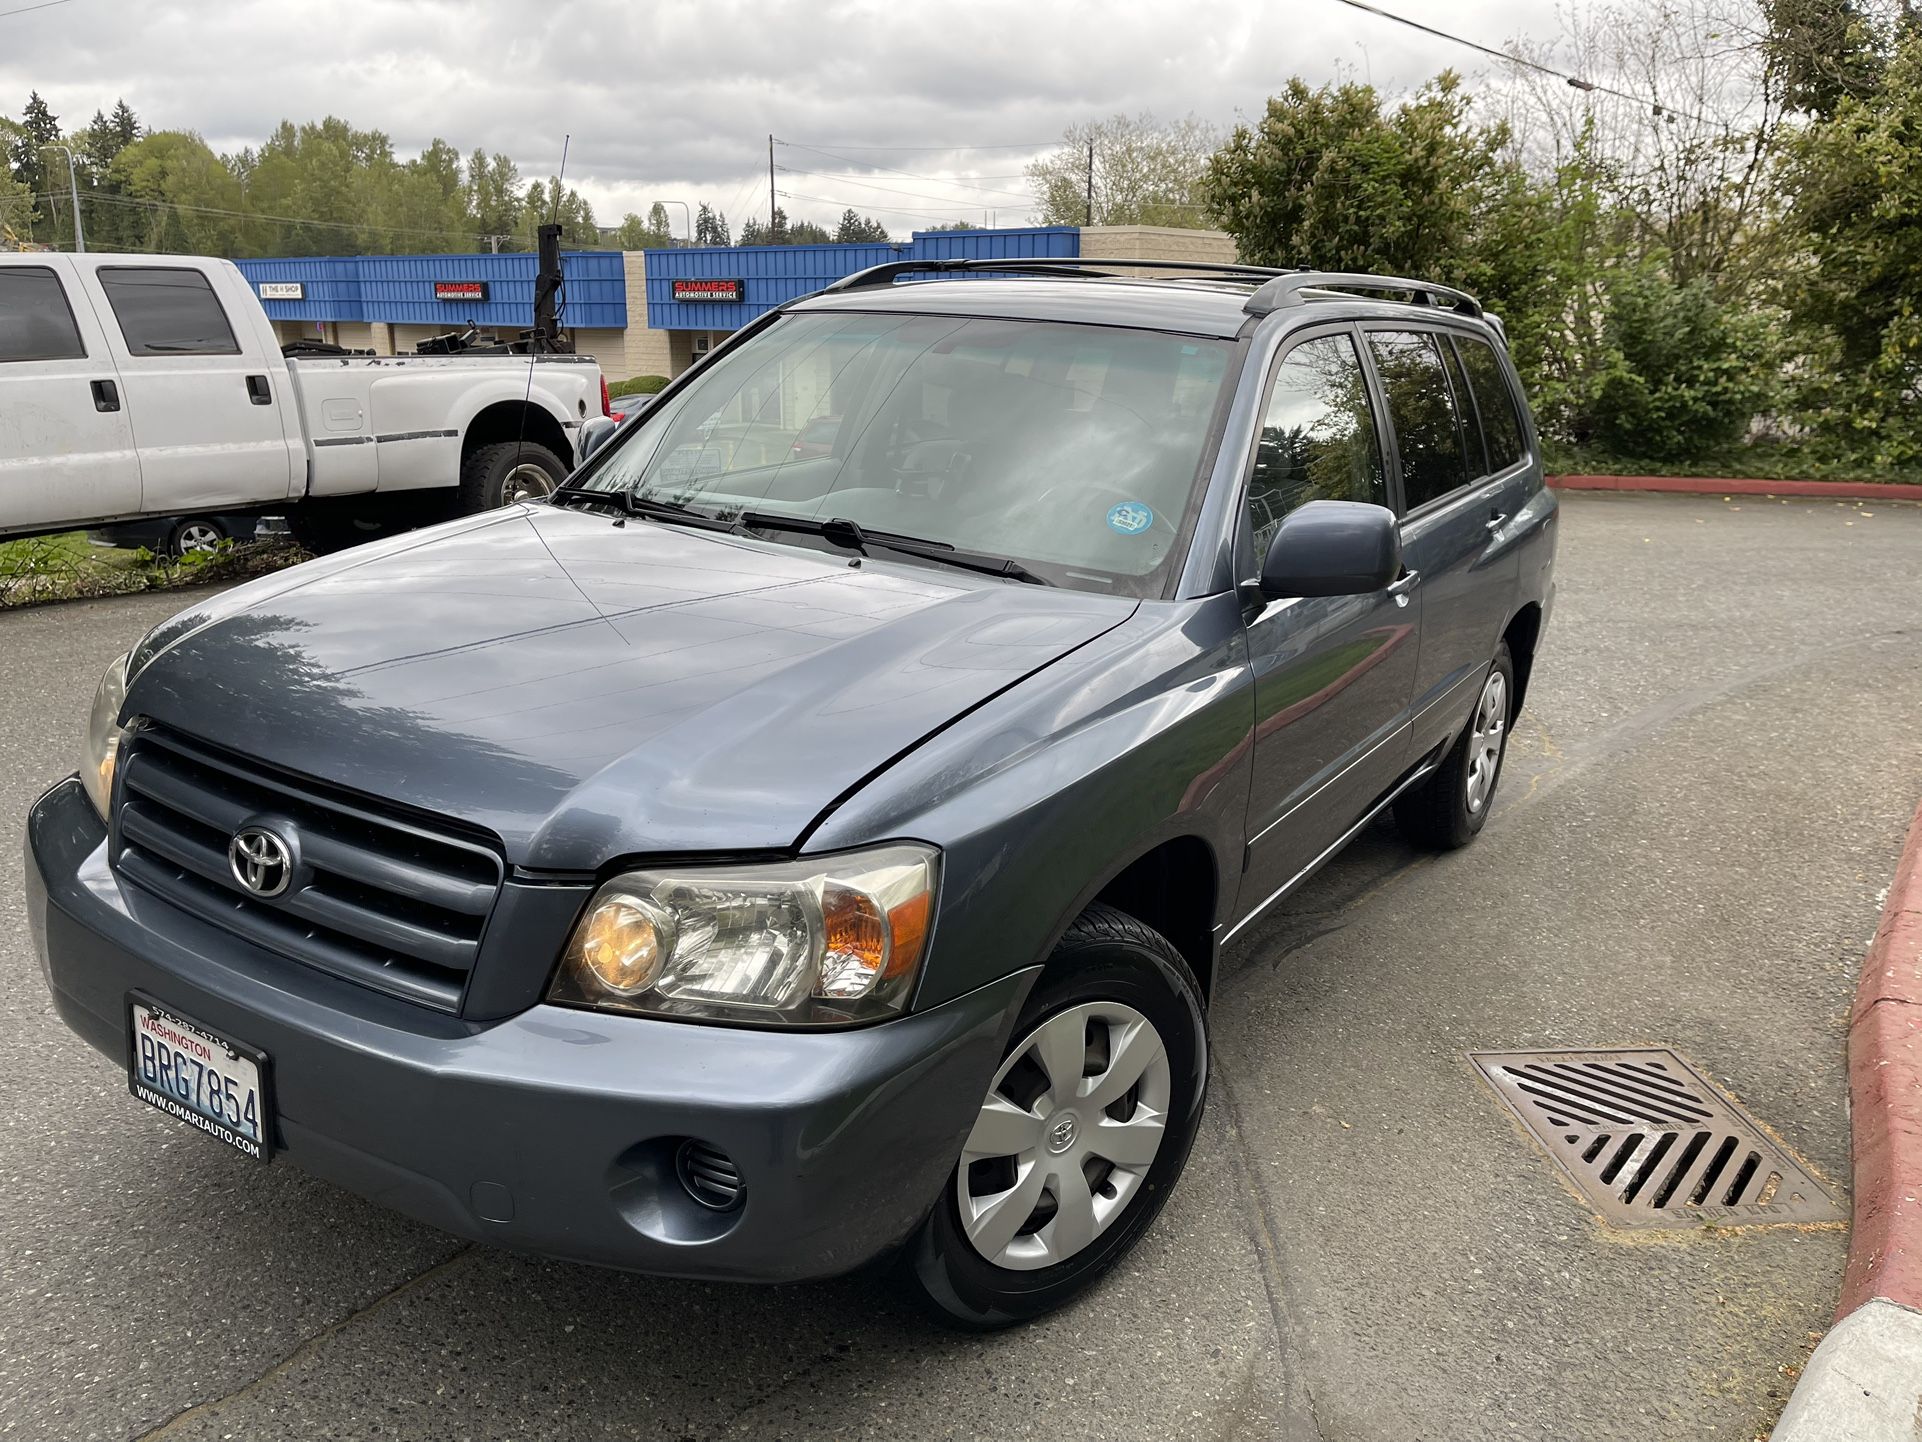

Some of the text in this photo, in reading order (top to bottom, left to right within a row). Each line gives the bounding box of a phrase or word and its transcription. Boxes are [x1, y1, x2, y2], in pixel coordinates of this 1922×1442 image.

[676, 282, 736, 291] SUMMERS
[140, 1014, 212, 1062] WASHINGTON
[141, 1032, 259, 1139] BRG7854
[136, 1084, 260, 1159] WWW.OMARIAUTO.COM
